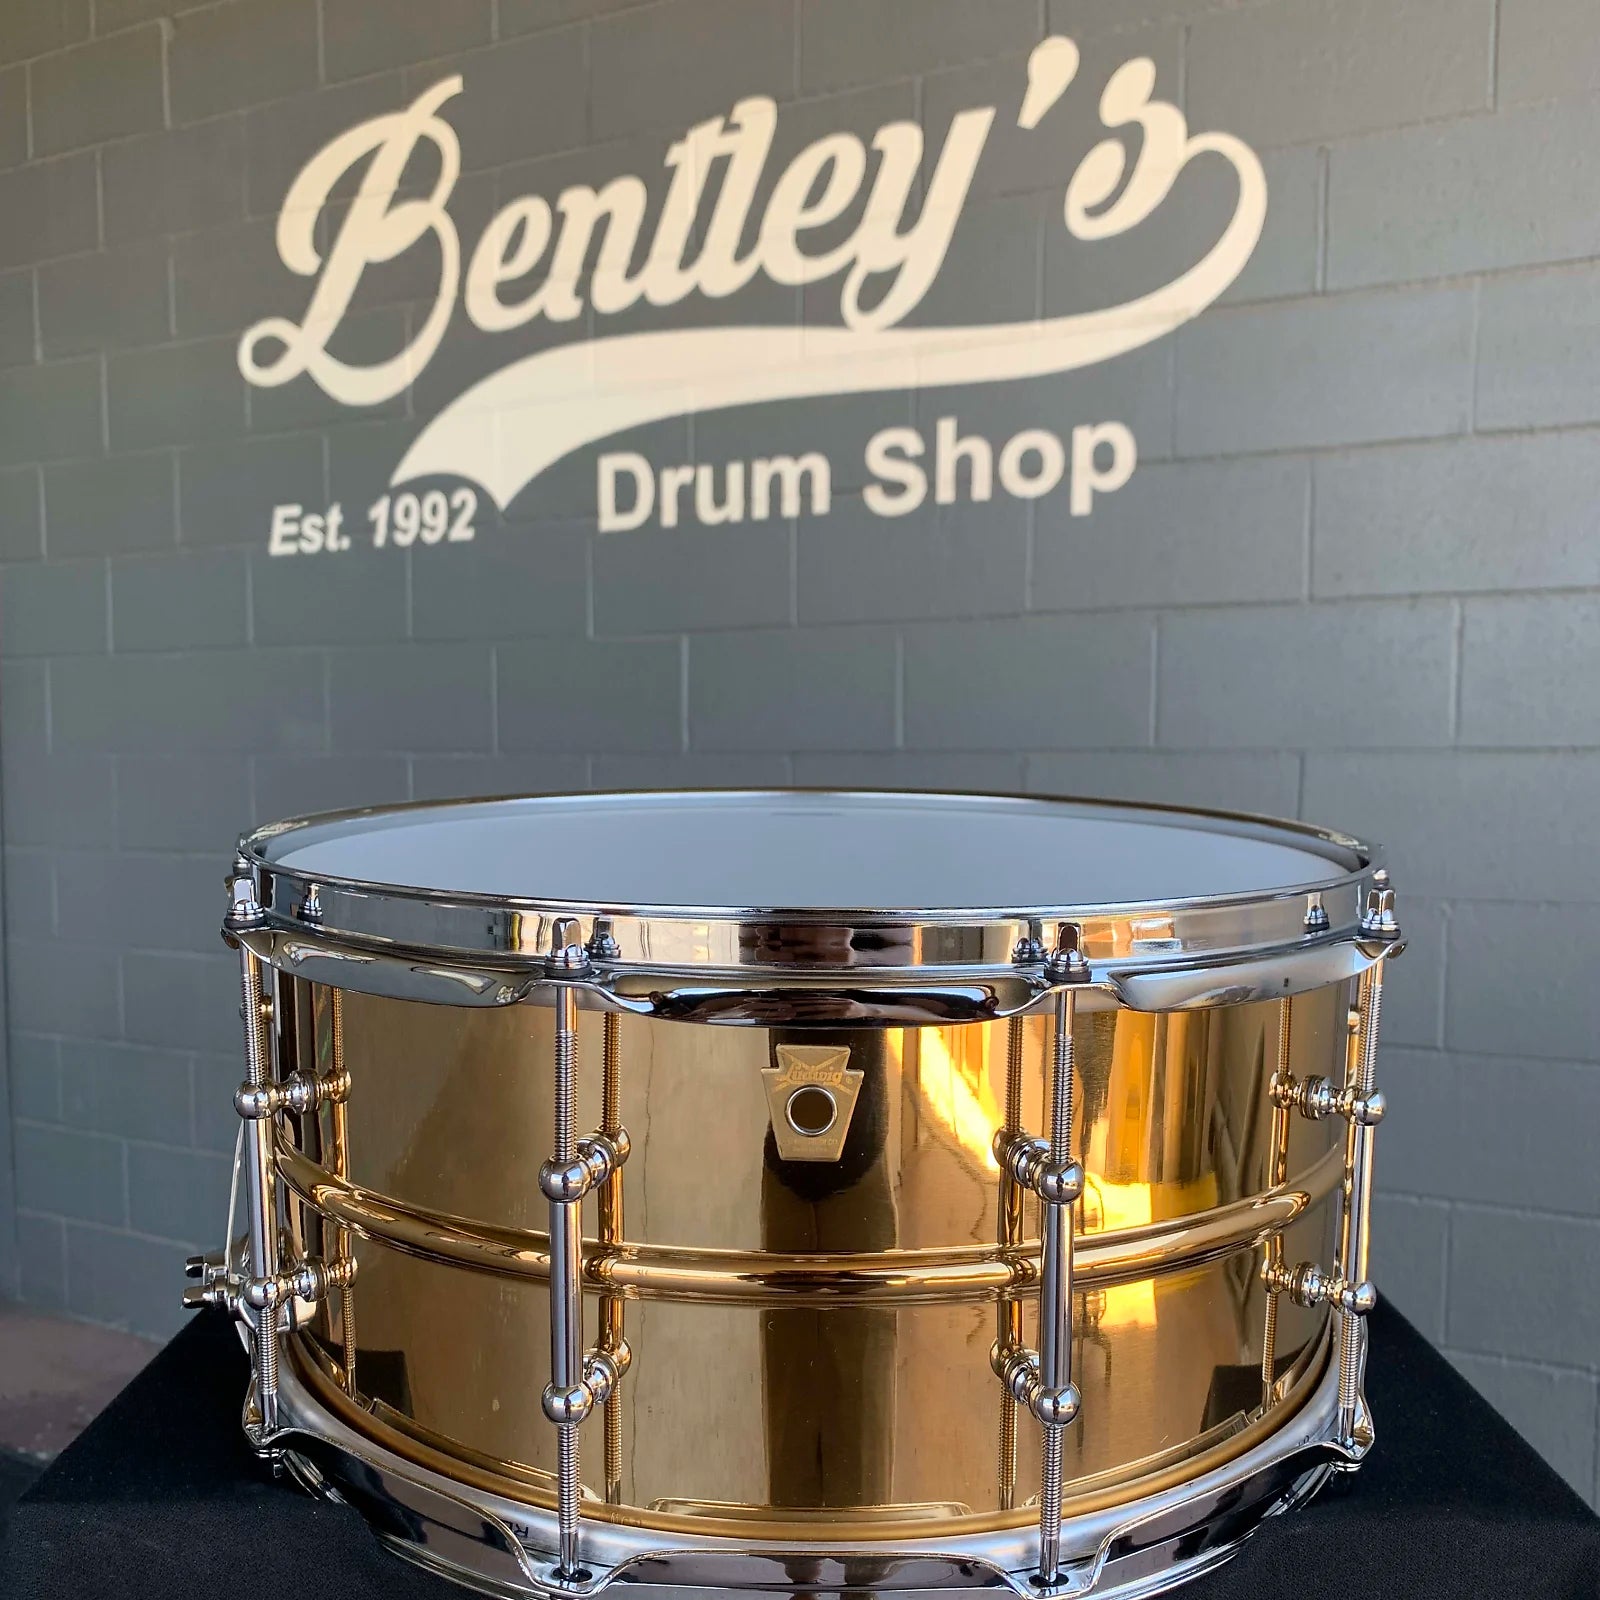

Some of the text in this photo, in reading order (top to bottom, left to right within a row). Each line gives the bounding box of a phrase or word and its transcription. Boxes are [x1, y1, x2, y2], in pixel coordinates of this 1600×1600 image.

[237, 36, 1269, 407] Bentley's
[597, 417, 1138, 534] Drum Shop
[268, 488, 478, 557] Est. 1992
[777, 1062, 843, 1085] Ludwig
